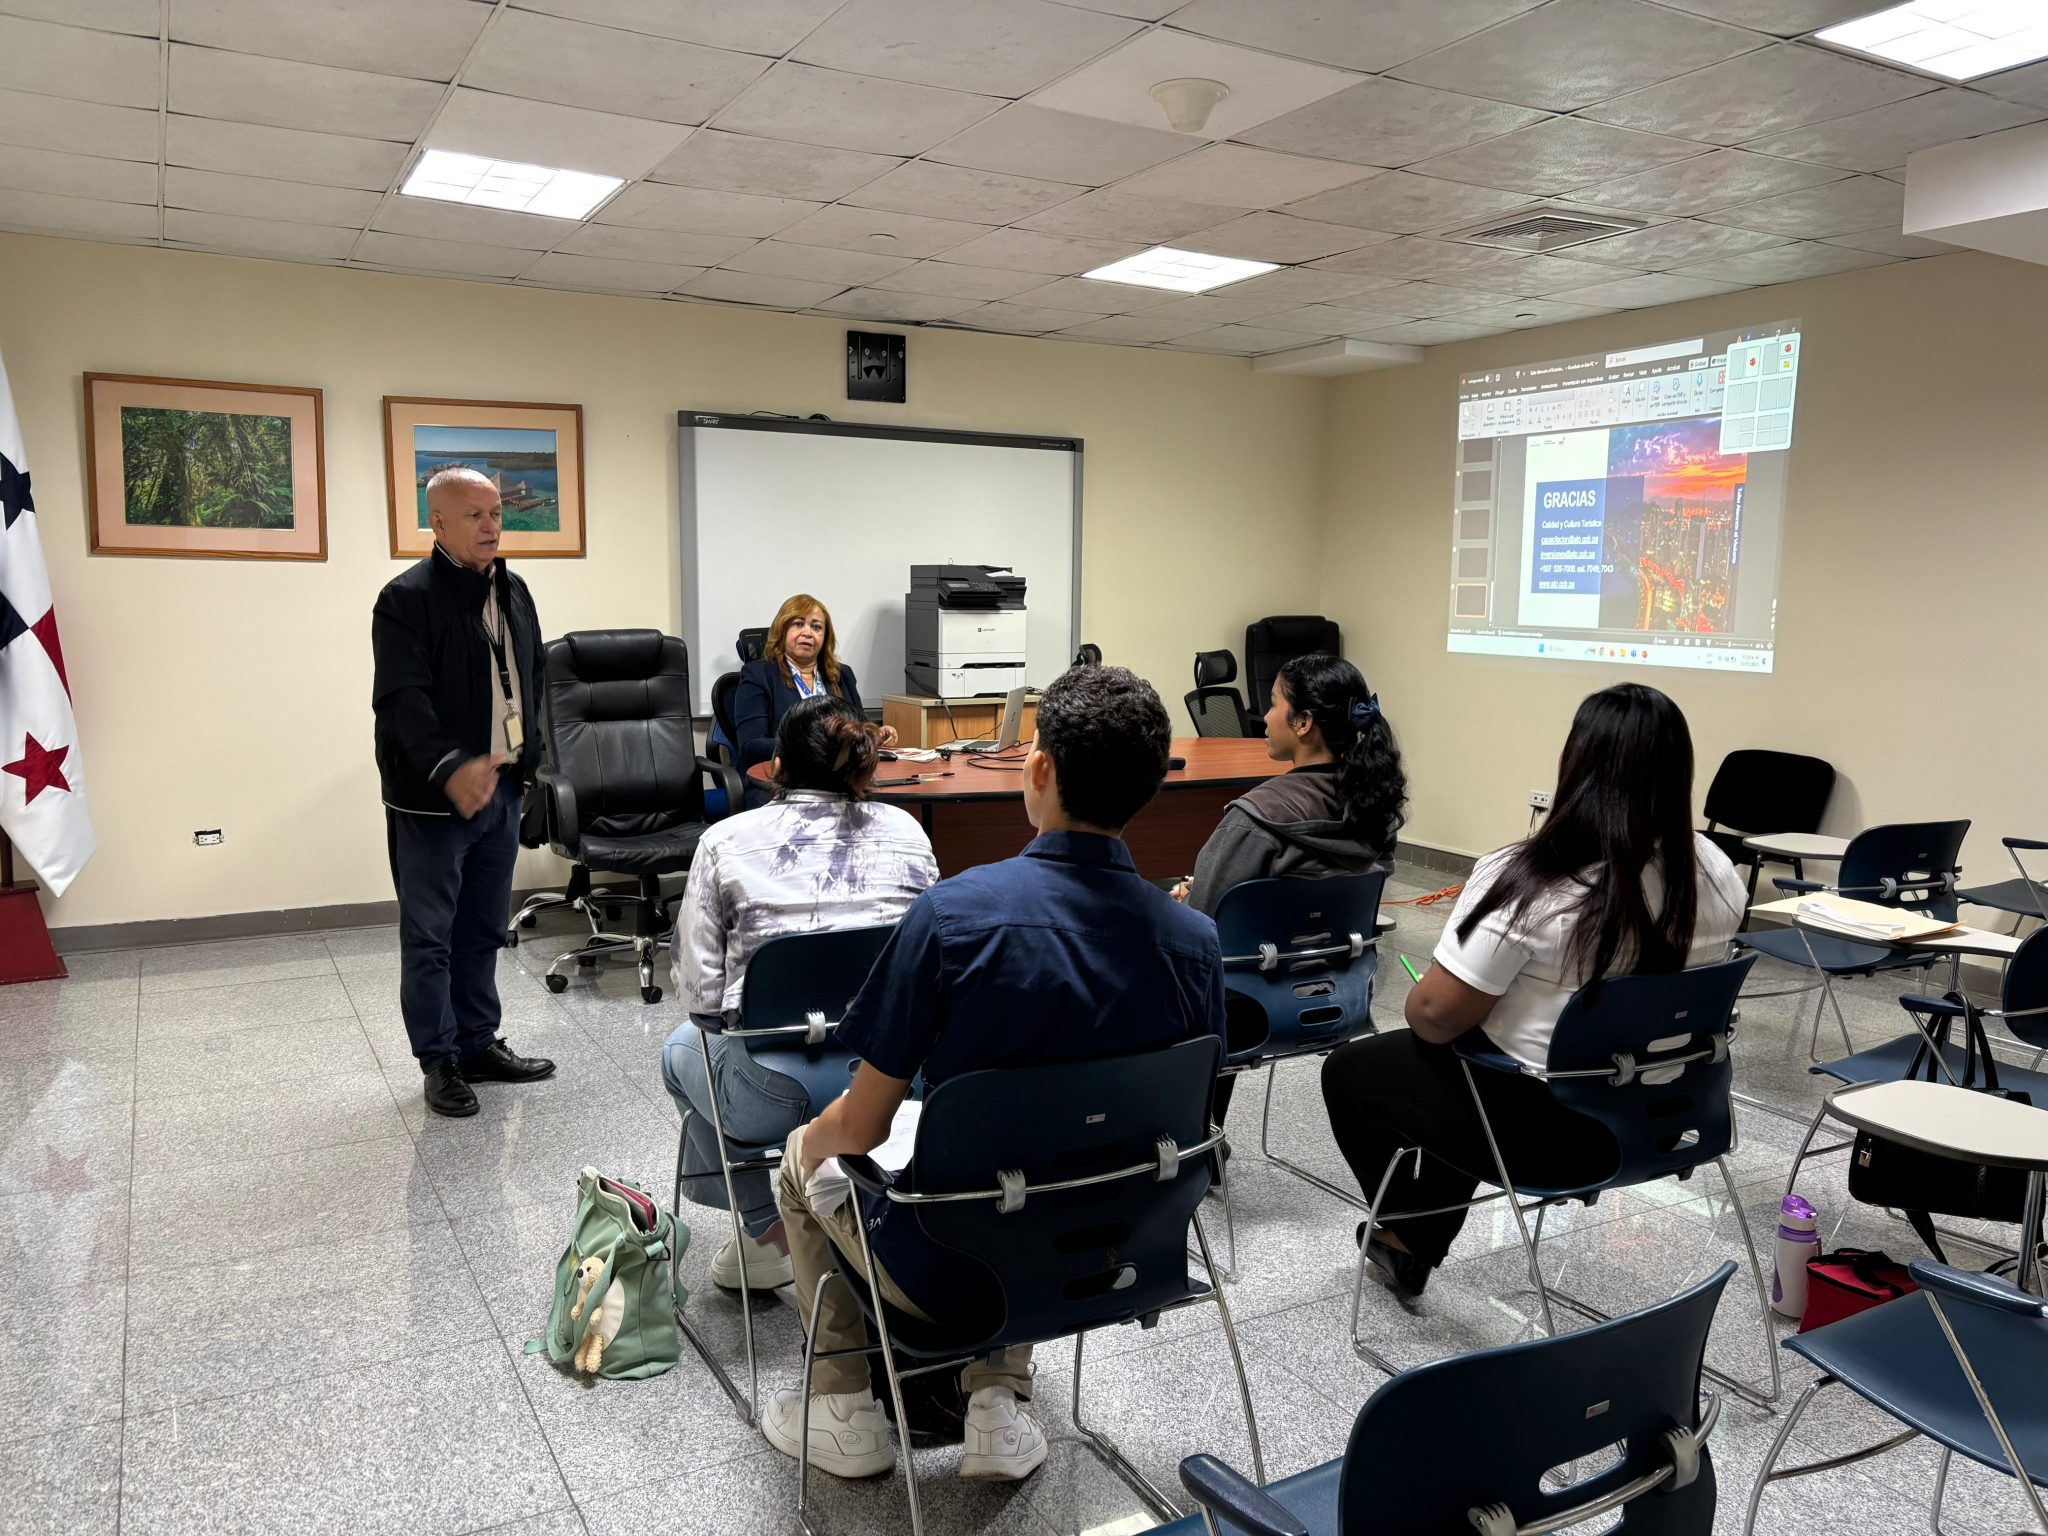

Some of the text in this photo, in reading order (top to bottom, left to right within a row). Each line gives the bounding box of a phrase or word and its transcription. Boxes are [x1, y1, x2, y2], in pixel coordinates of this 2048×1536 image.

[1543, 490, 1596, 508] GRACIAS
[1542, 520, 1559, 529] Calidad
[1564, 520, 1581, 528] Cultura
